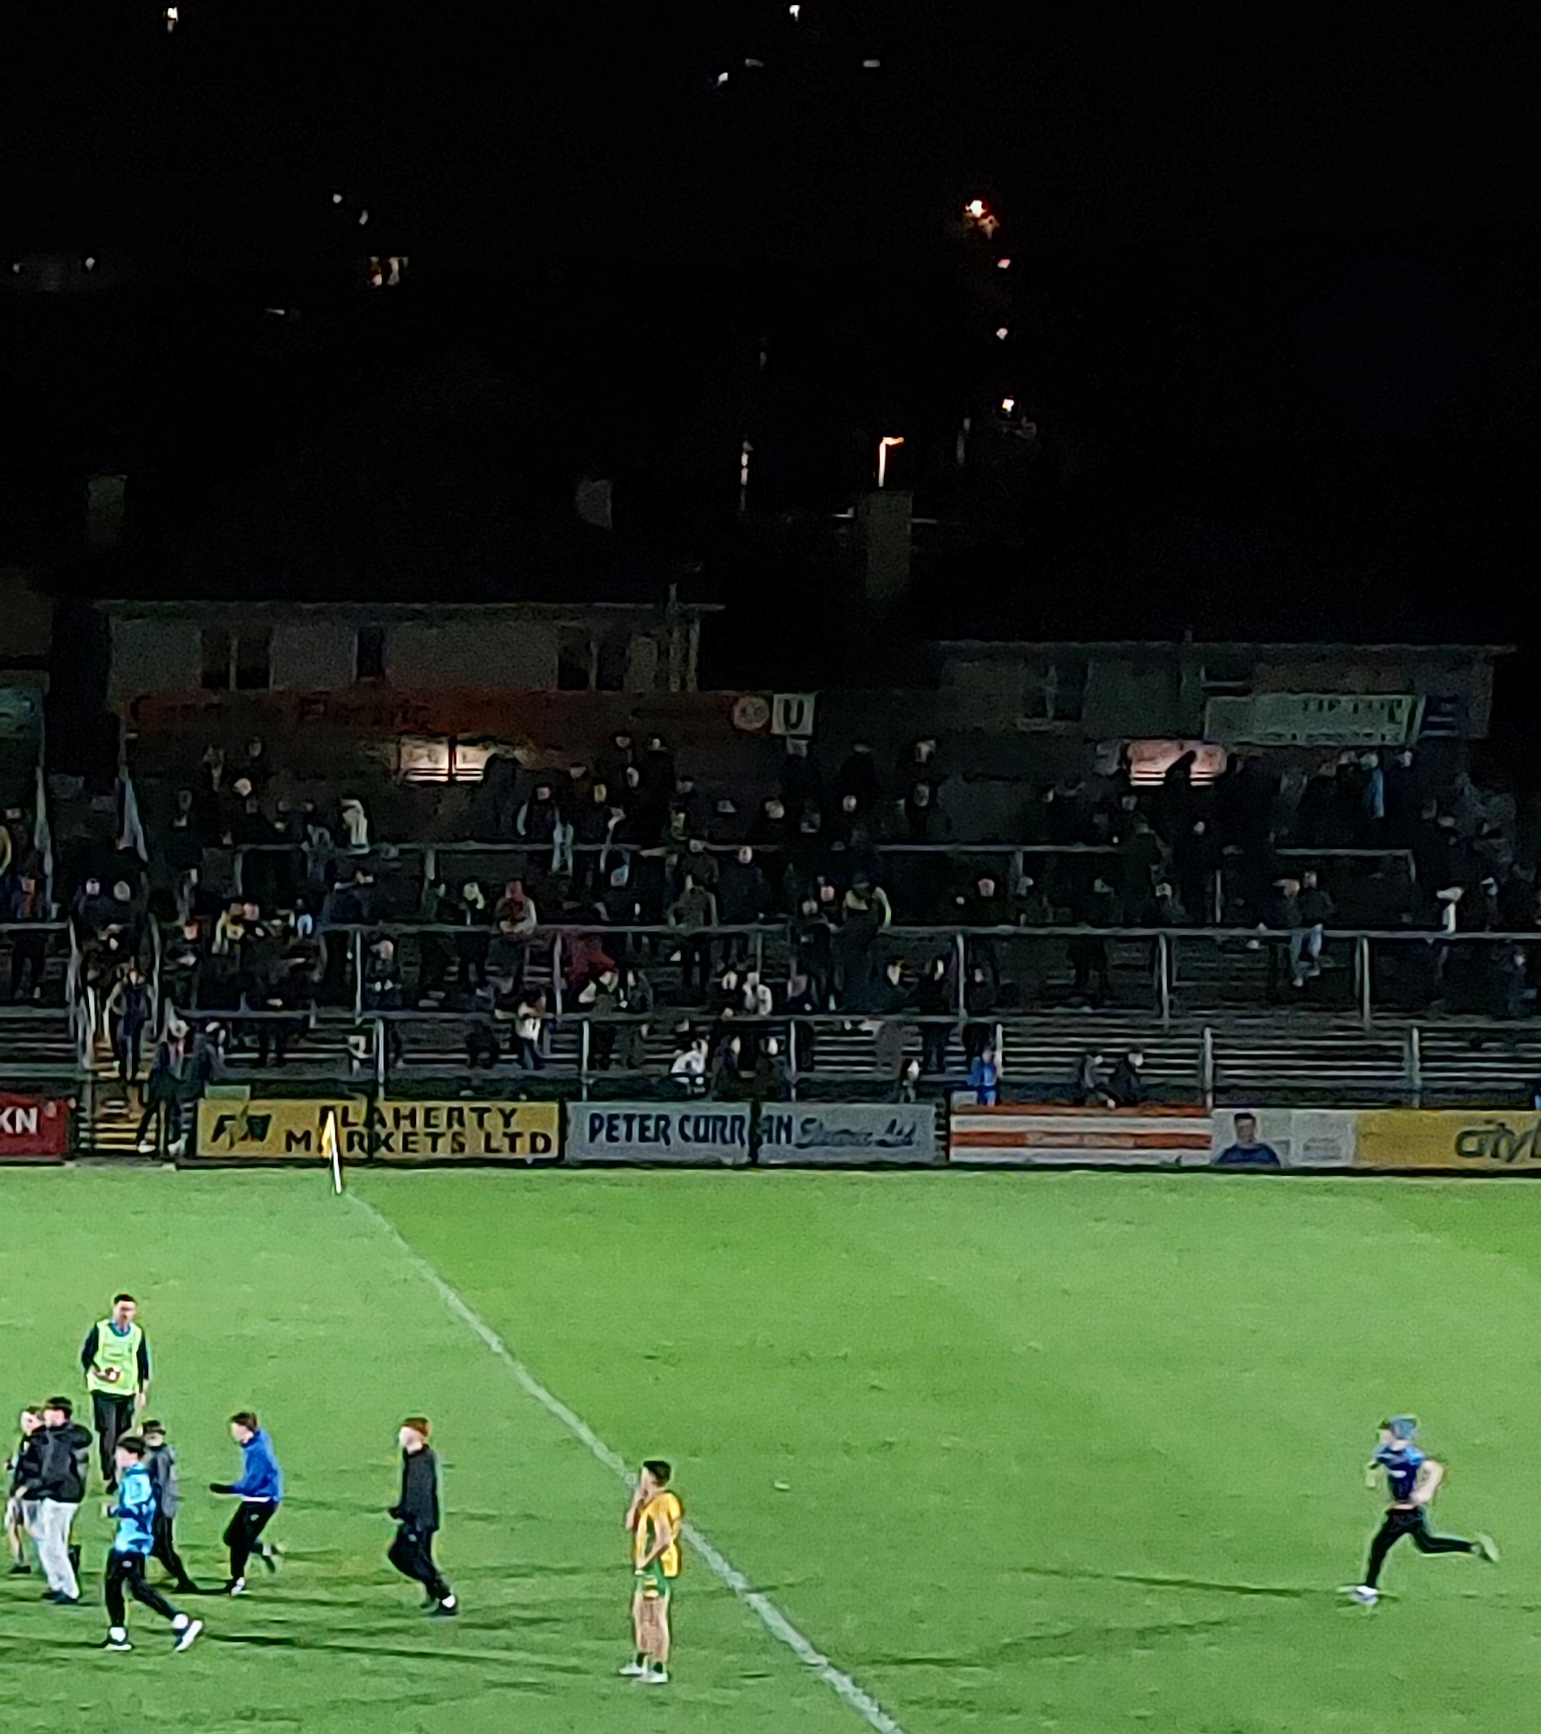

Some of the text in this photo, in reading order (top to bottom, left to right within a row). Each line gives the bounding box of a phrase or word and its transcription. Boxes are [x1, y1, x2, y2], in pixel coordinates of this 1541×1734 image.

[284, 1129, 553, 1155] MRKETS LTD
[588, 1113, 671, 1146] PETER
